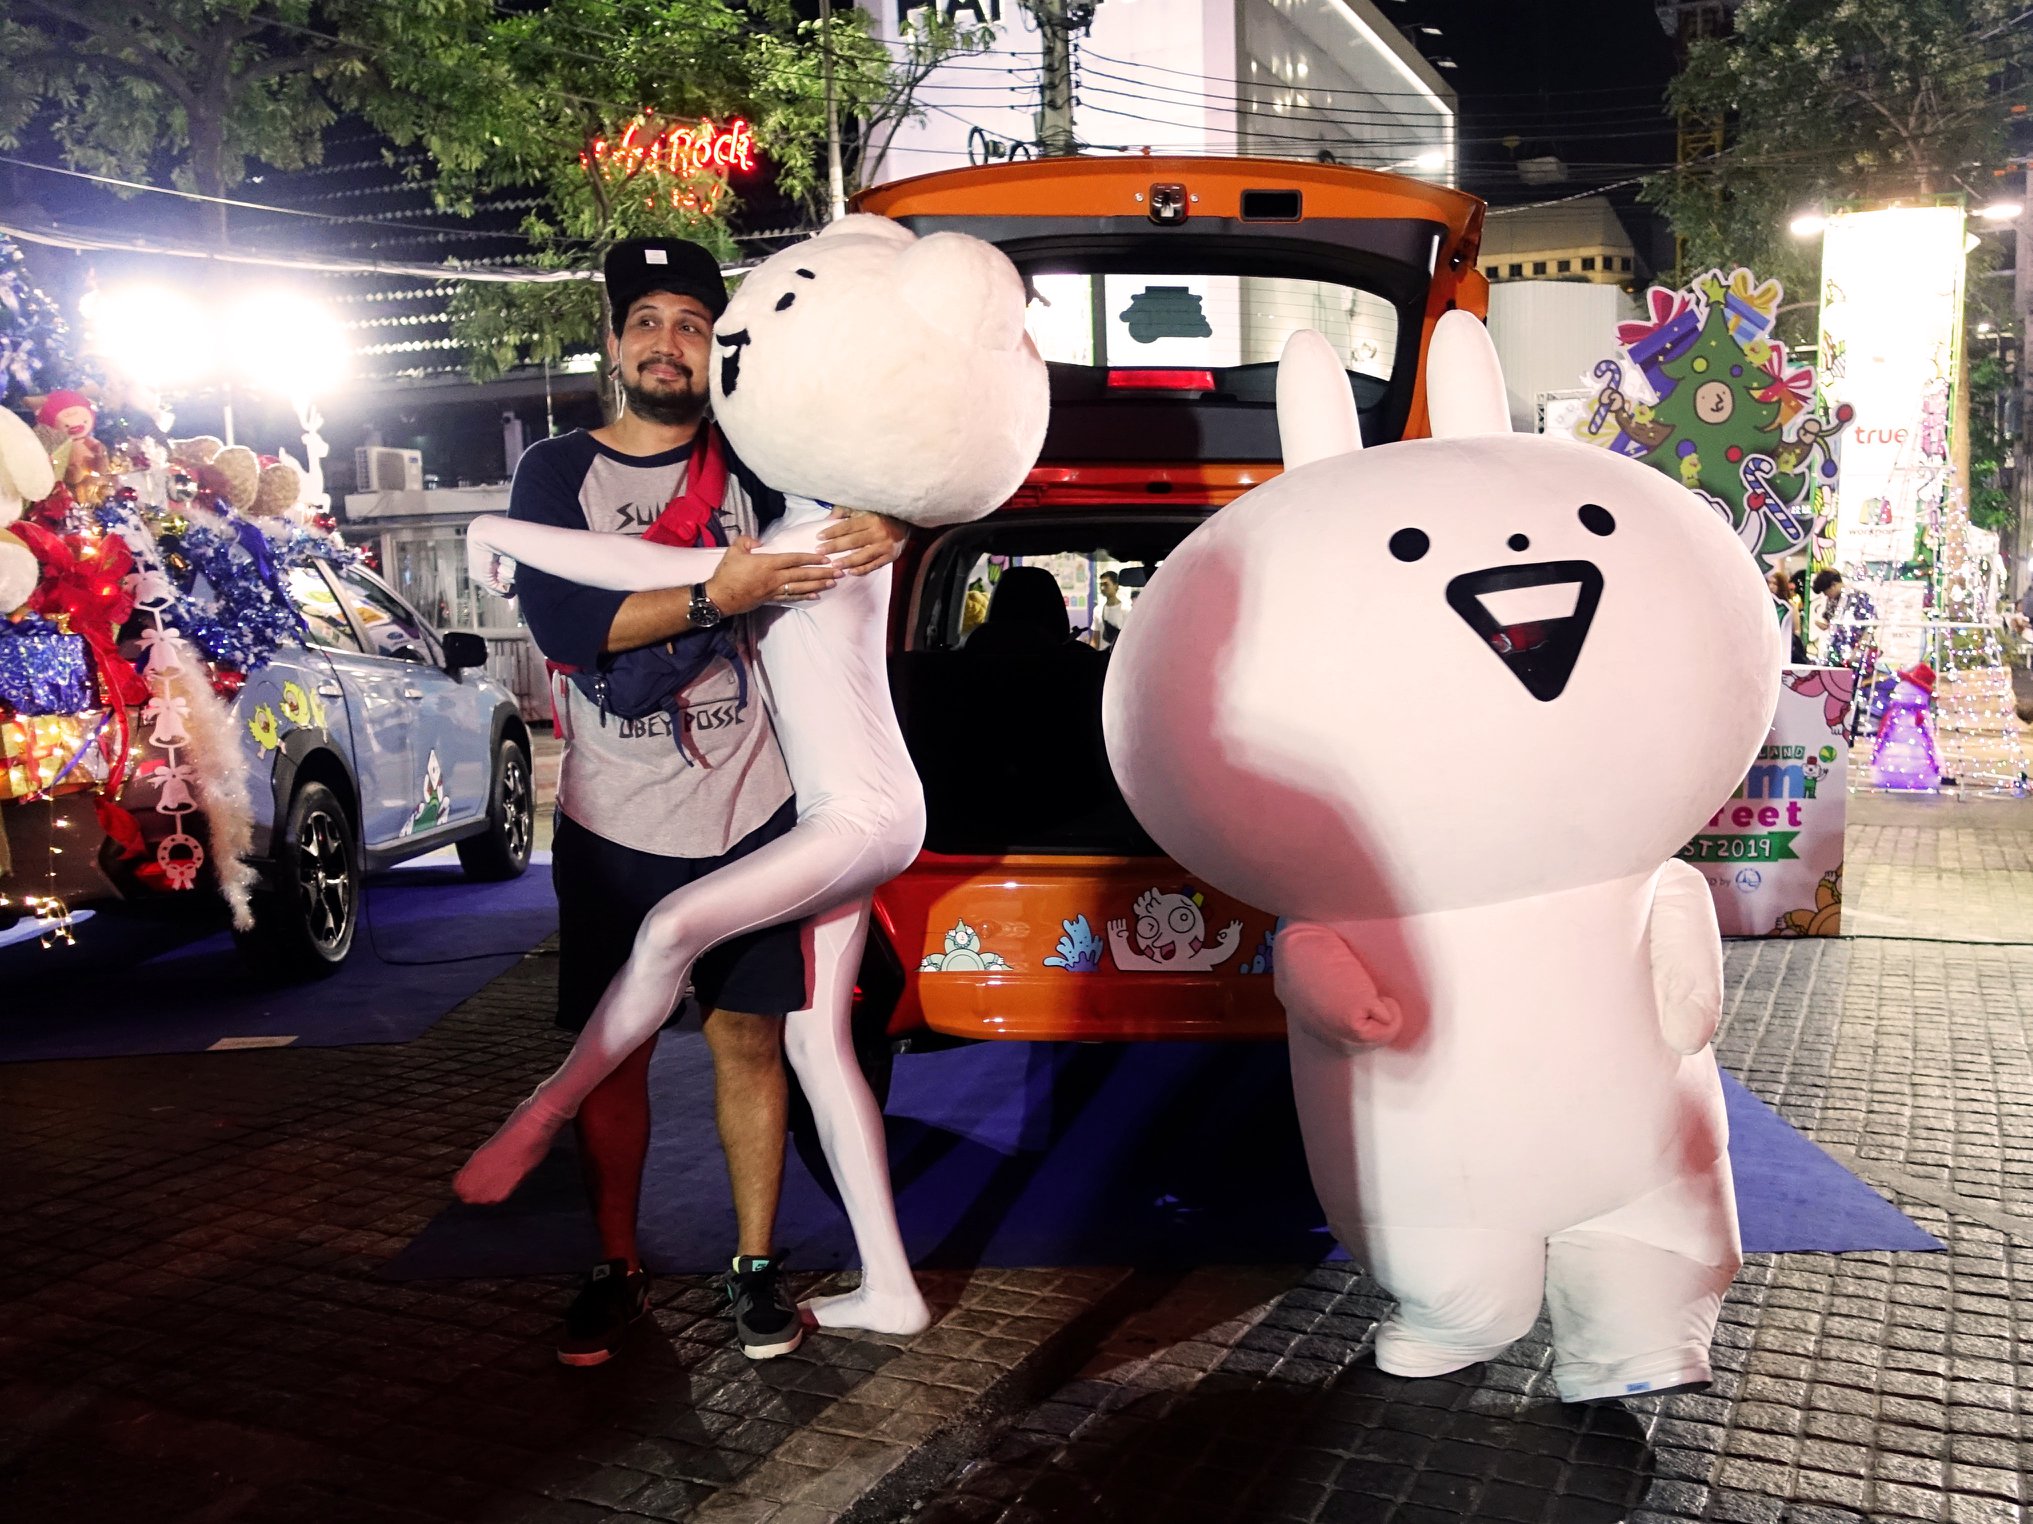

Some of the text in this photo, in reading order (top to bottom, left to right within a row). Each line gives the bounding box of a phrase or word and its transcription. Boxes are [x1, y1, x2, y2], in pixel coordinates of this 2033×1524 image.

[1855, 426, 1909, 444] true
[1758, 746, 1805, 758] LAND
[1708, 801, 1803, 828] reet
